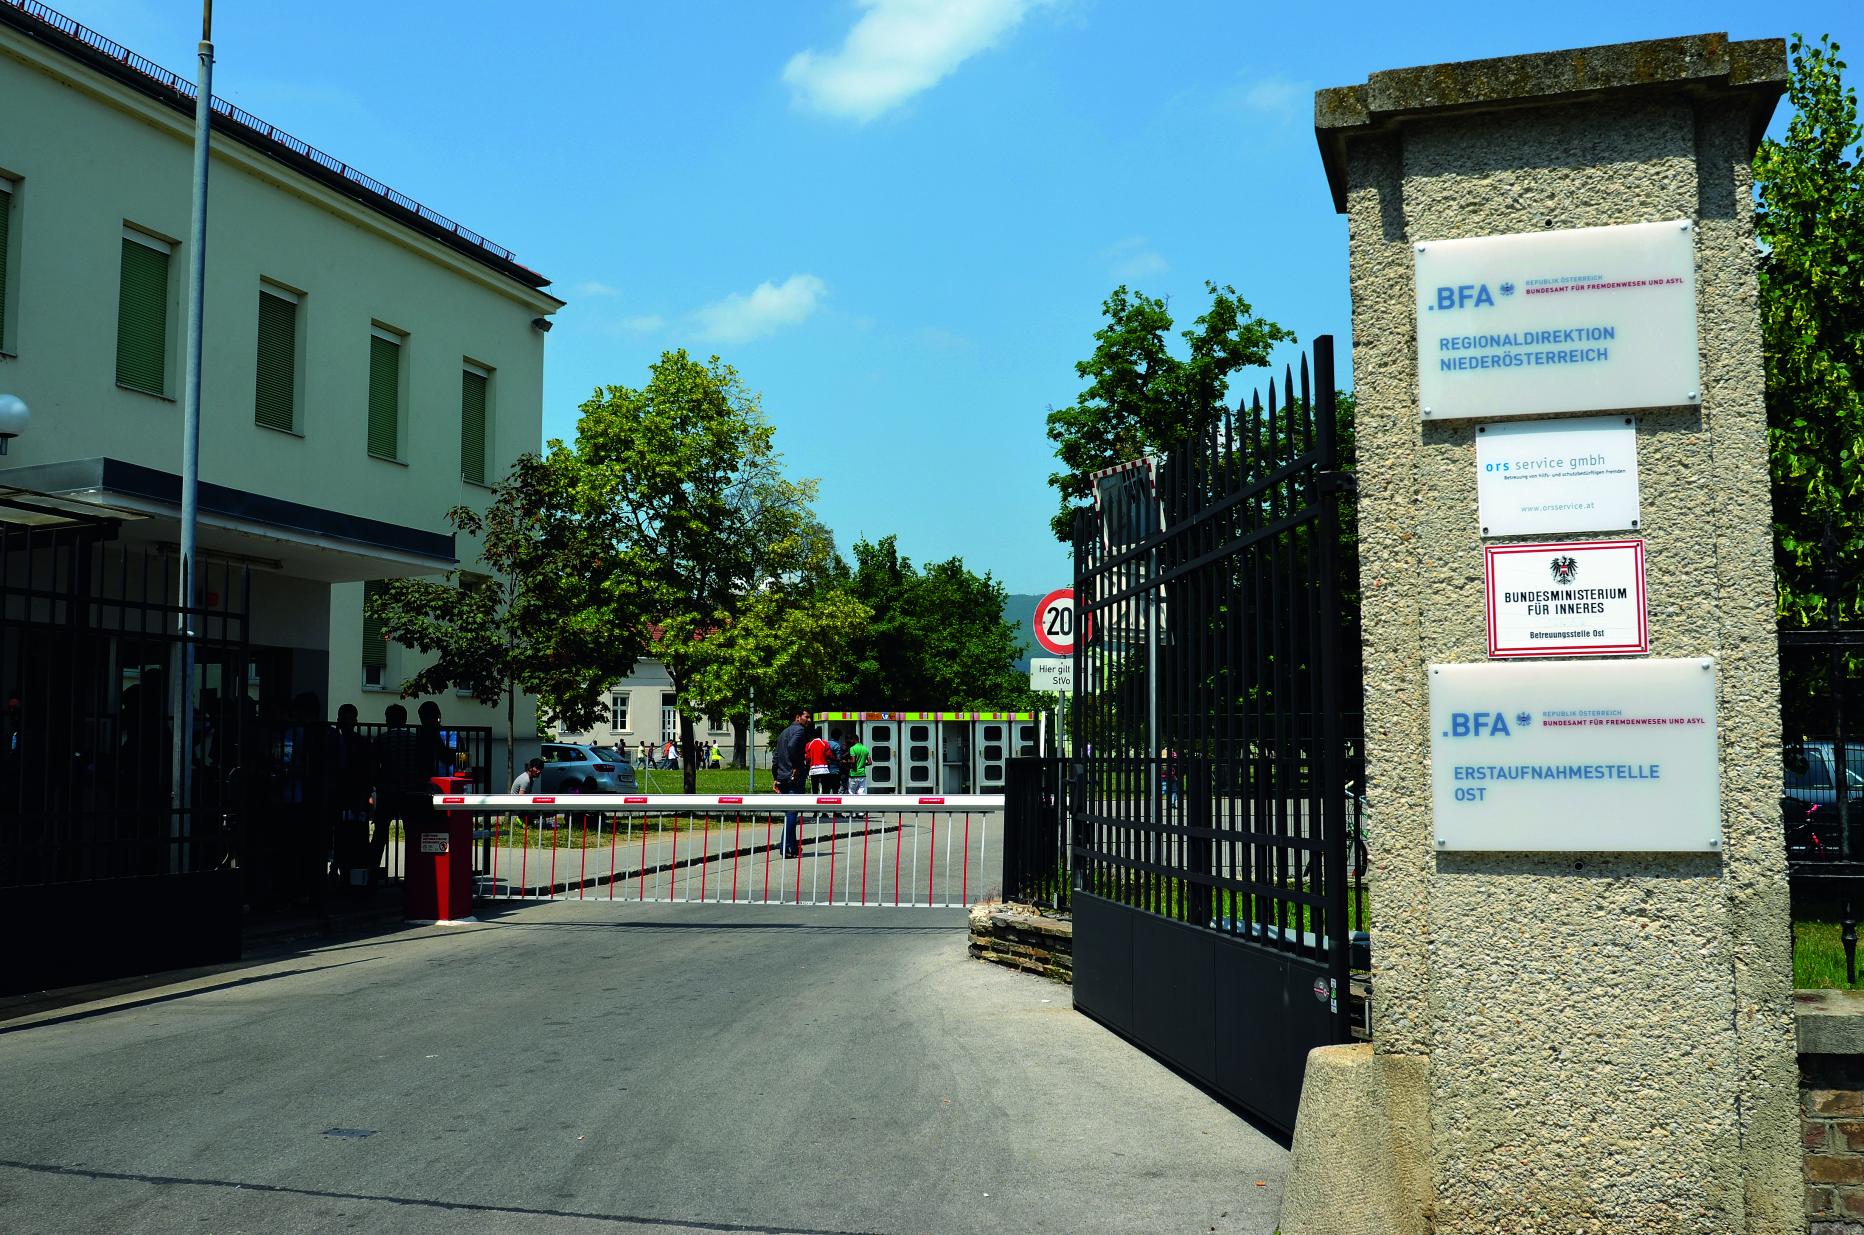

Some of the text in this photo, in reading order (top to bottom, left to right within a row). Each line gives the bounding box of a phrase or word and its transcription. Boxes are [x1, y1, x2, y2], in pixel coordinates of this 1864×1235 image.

[1525, 274, 1603, 286] REPUBLIK ÖSTERREICH
[1525, 277, 1684, 295] BUNDESAMT FÜR FREMDENWESEN UND ASYL
[1427, 283, 1495, 311] .BFA
[1439, 326, 1615, 351] REGIONALDIREKTION
[1440, 348, 1608, 371] NIEDERÖSTERREICH
[1486, 454, 1605, 473] ors service gmbh
[1521, 501, 1595, 513] www.orsservice.at
[1504, 588, 1628, 604] BUNDESMINISTERIUM
[1527, 602, 1605, 616] FÜR INNERES
[1047, 606, 1072, 636] 20
[1530, 629, 1605, 639] Betreuungsstelle Ost
[1039, 664, 1056, 673] Hier
[1058, 664, 1071, 675] gilt
[1053, 676, 1071, 685] StVo
[1578, 708, 1622, 717] ÖSTERREICH
[1442, 712, 1511, 737] .BFA
[1542, 719, 1587, 727] BUNDESAMT
[1589, 717, 1604, 726] FÜR
[1605, 718, 1667, 726] FREMDENWESEN
[1686, 717, 1706, 725] ASYL
[1454, 764, 1660, 780] ERSTAUFNAHMESTELLE
[1454, 787, 1487, 802] OST
